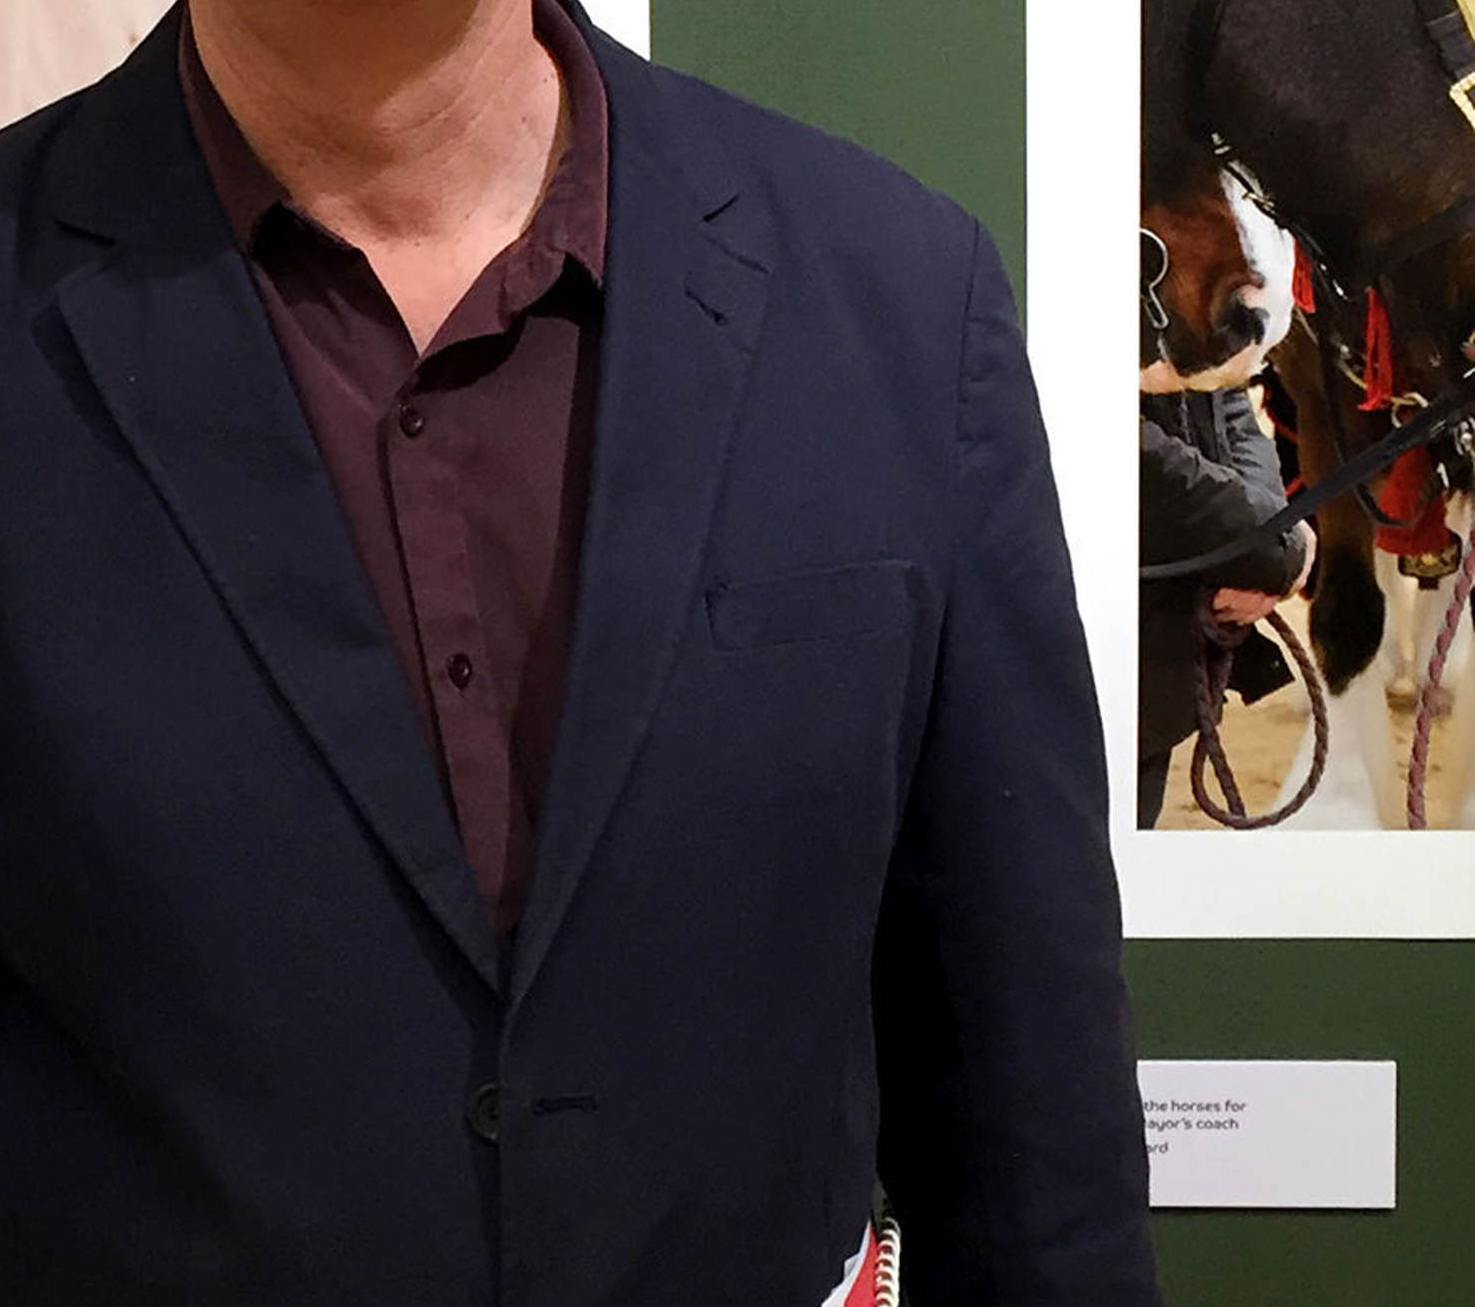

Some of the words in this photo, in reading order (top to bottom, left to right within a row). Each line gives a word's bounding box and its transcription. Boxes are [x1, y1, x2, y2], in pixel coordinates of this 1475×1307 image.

[1144, 1100, 1168, 1112] the
[1171, 1099, 1220, 1112] horses
[1225, 1099, 1246, 1112] for
[1146, 1119, 1193, 1131] ayor's
[1195, 1119, 1239, 1129] coach
